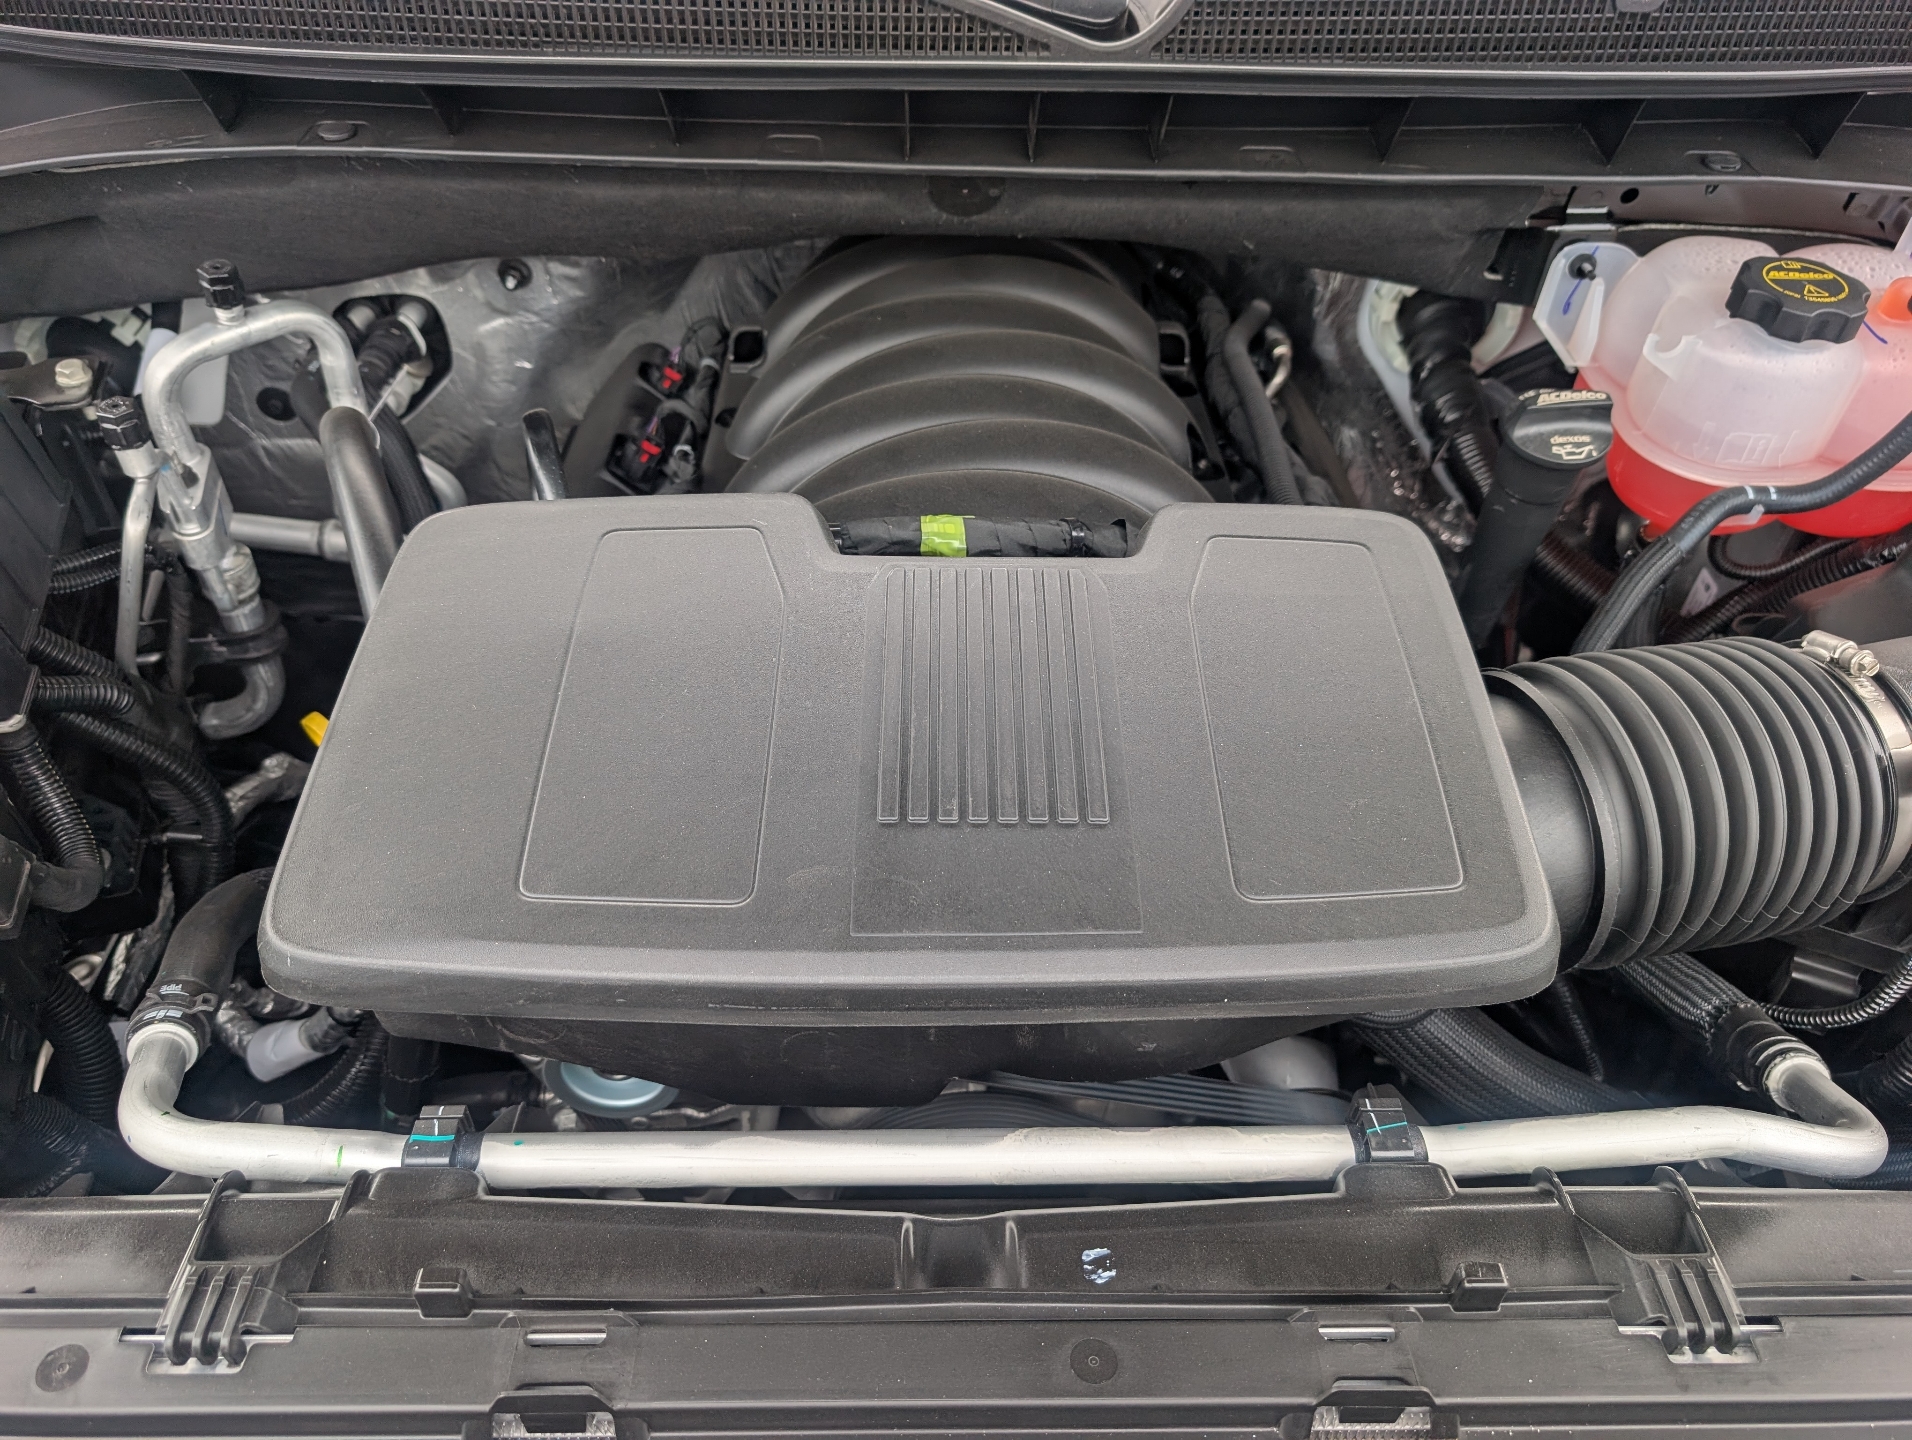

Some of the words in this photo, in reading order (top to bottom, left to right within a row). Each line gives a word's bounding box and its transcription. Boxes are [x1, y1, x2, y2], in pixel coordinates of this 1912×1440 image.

[1767, 270, 1834, 280] ACDelco
[1537, 389, 1607, 405] ACDelco
[1550, 434, 1591, 445] dexos
